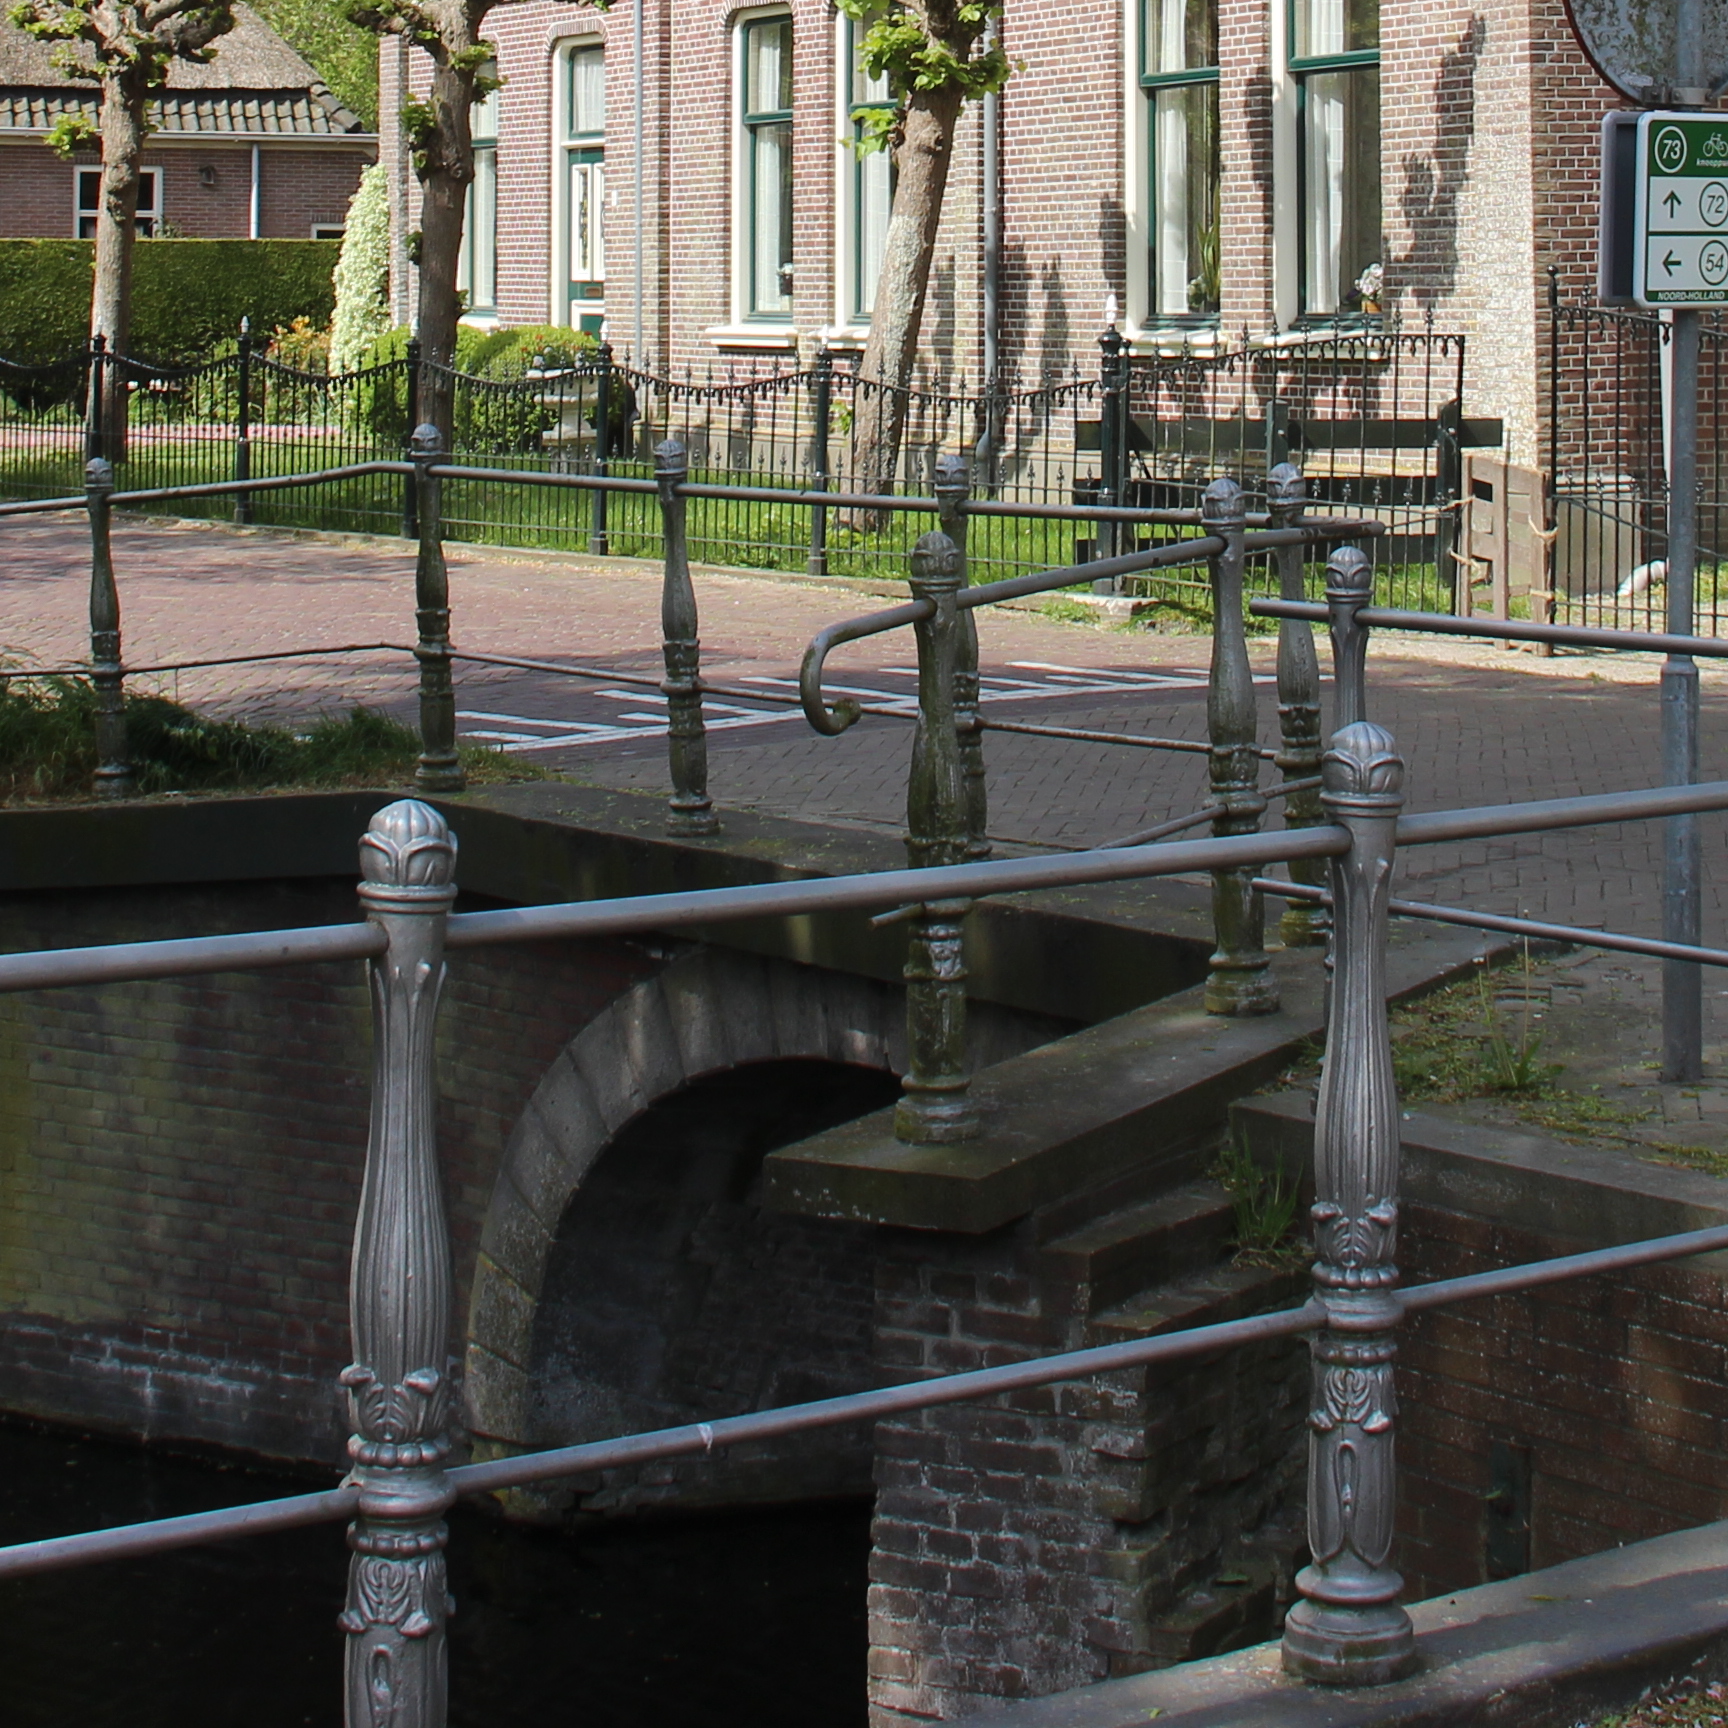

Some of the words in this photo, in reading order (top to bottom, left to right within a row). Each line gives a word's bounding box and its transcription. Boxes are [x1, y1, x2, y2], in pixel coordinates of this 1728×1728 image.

[1662, 139, 1681, 159] 73
[1706, 195, 1725, 214] 72
[1705, 253, 1724, 272] 54
[1657, 291, 1725, 301] NOORD-HOLLAND
